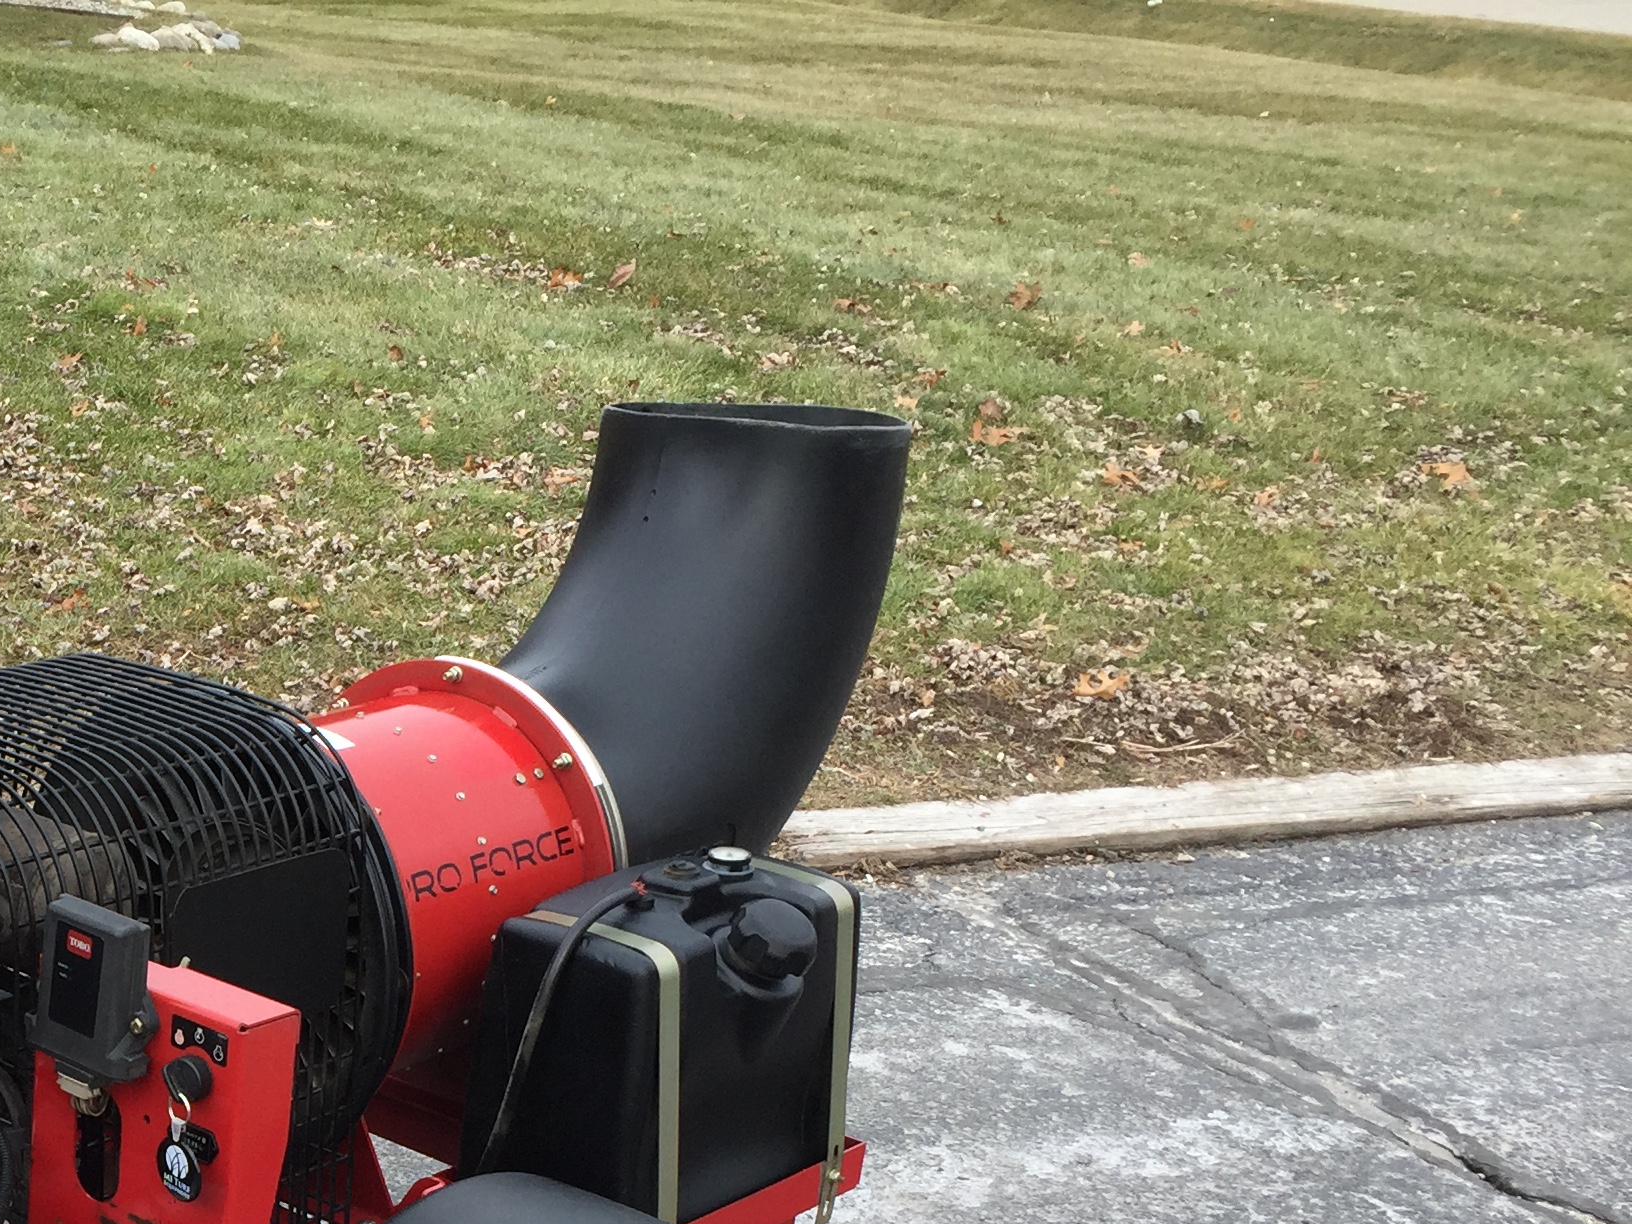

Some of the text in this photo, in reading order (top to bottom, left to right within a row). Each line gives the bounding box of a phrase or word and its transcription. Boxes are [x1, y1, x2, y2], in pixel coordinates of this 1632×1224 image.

[406, 826, 574, 902] RO FORCE
[69, 935, 92, 954] TORO
